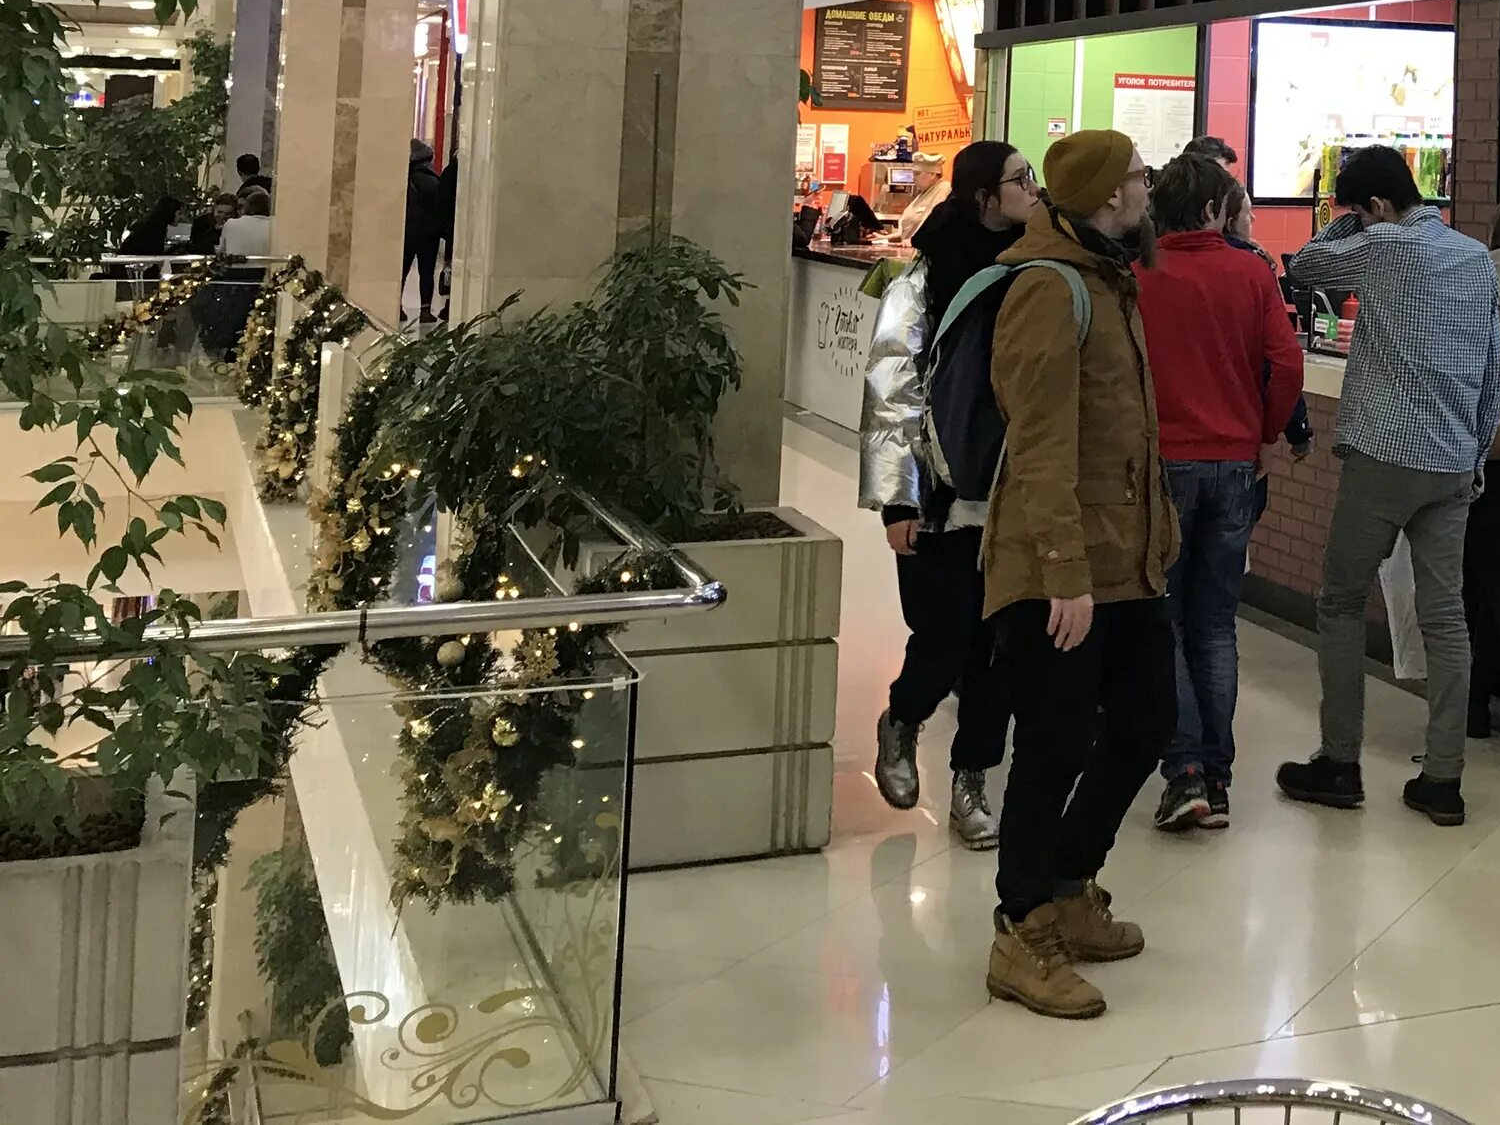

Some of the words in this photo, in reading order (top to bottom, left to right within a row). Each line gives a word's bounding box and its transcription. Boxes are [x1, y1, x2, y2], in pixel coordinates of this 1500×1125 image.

[825, 10, 866, 20] ДОМАШНИЕ
[868, 11, 894, 22] ОБЕДЫ
[1117, 77, 1145, 86] УГОЛОК
[918, 127, 971, 144] НАТУРАЛЬН
